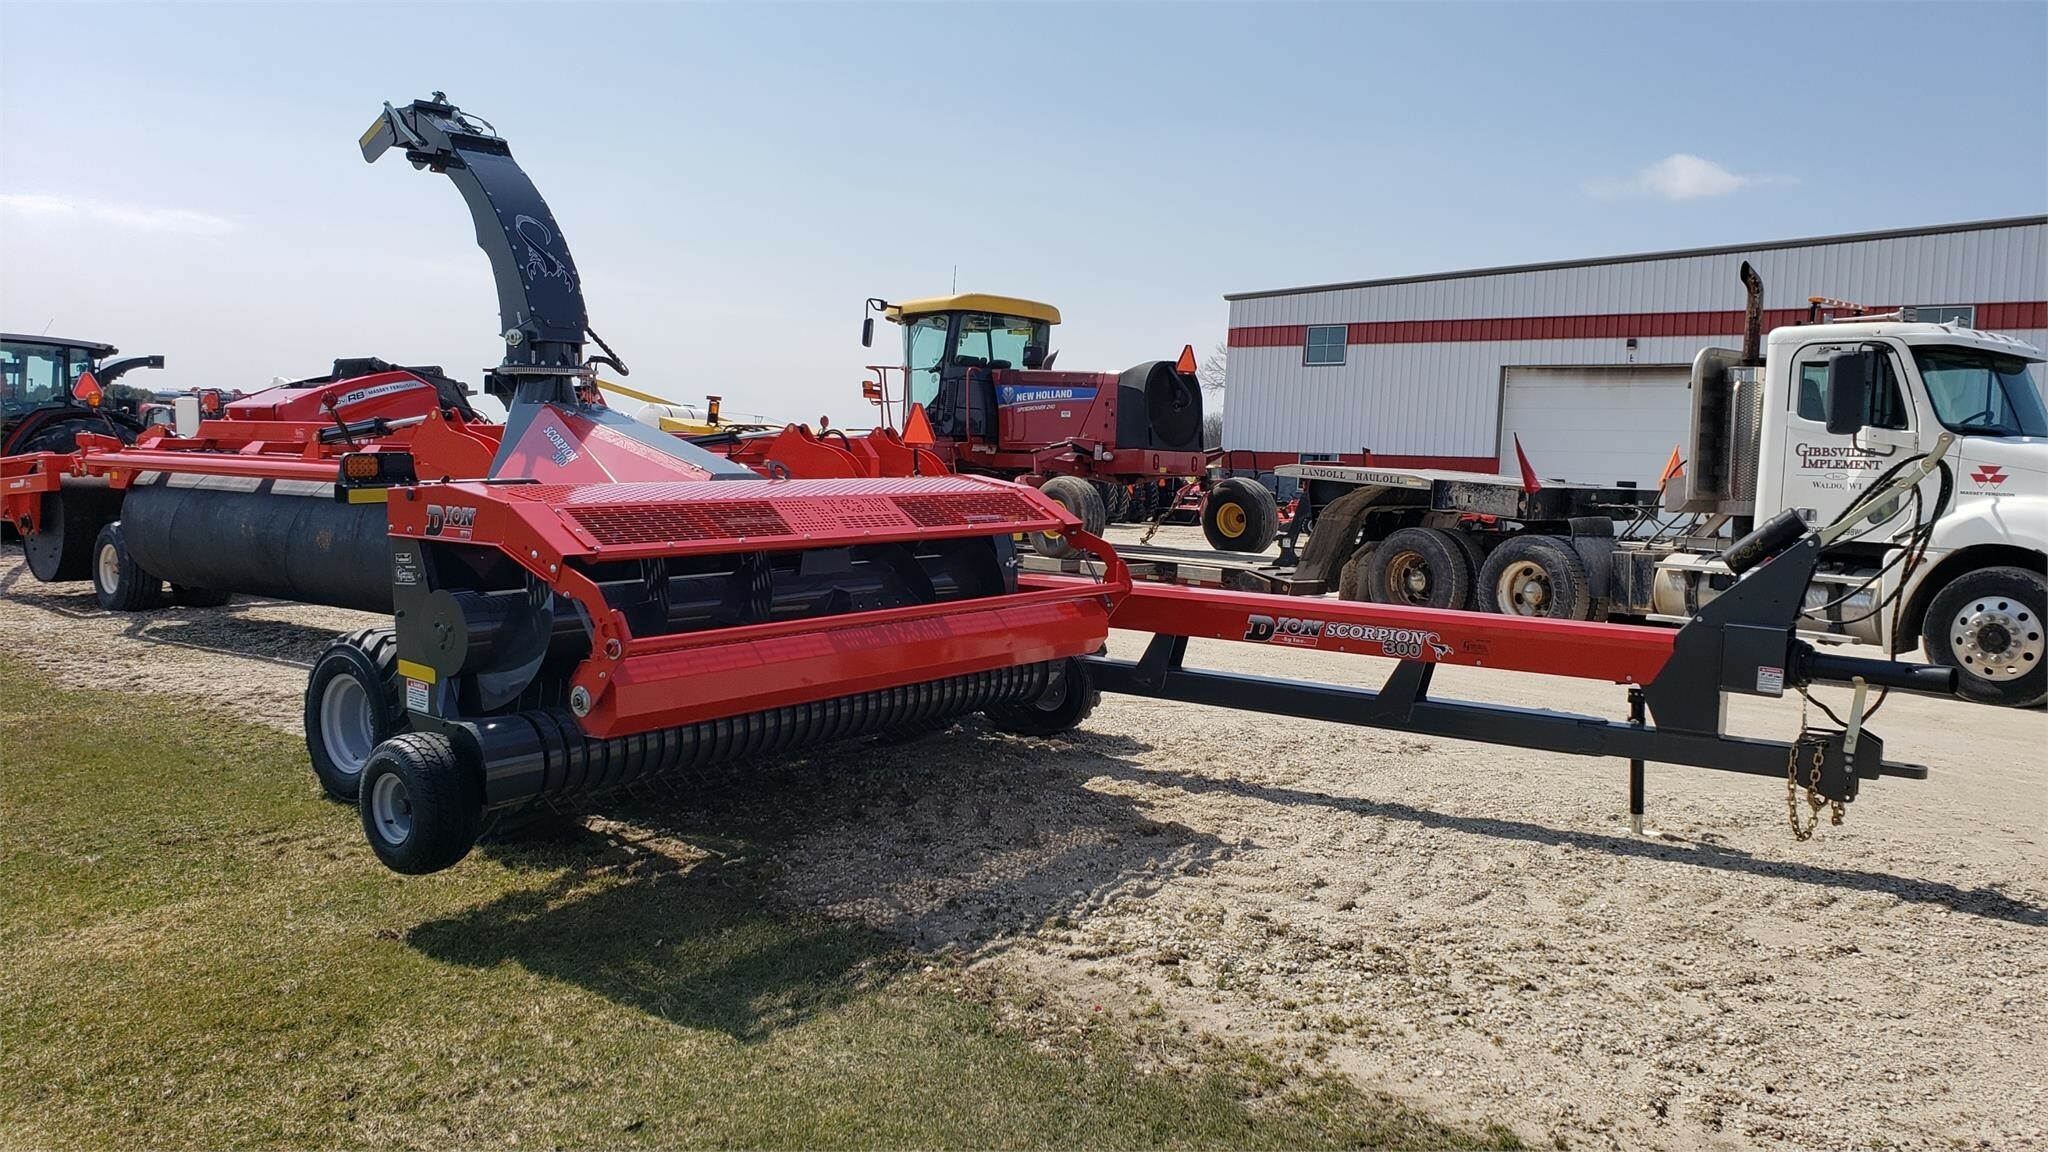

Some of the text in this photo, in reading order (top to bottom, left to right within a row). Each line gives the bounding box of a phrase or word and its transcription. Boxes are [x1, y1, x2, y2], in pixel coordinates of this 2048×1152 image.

[367, 387, 389, 395] MASSEY
[1016, 389, 1073, 402] NEW HOLLAND
[543, 426, 579, 462] SCORPION
[1795, 442, 1876, 457] GIBBSVILLE
[552, 451, 569, 467] 300
[1801, 450, 1883, 470] IMPLEMENT
[1301, 468, 1346, 480] LANDOLL
[1355, 472, 1404, 485] HAULOLL
[1812, 481, 1863, 490] WALDO, WI
[424, 504, 477, 538] DION
[1243, 613, 1427, 645] DION SCORPION
[1382, 640, 1423, 659] 300
